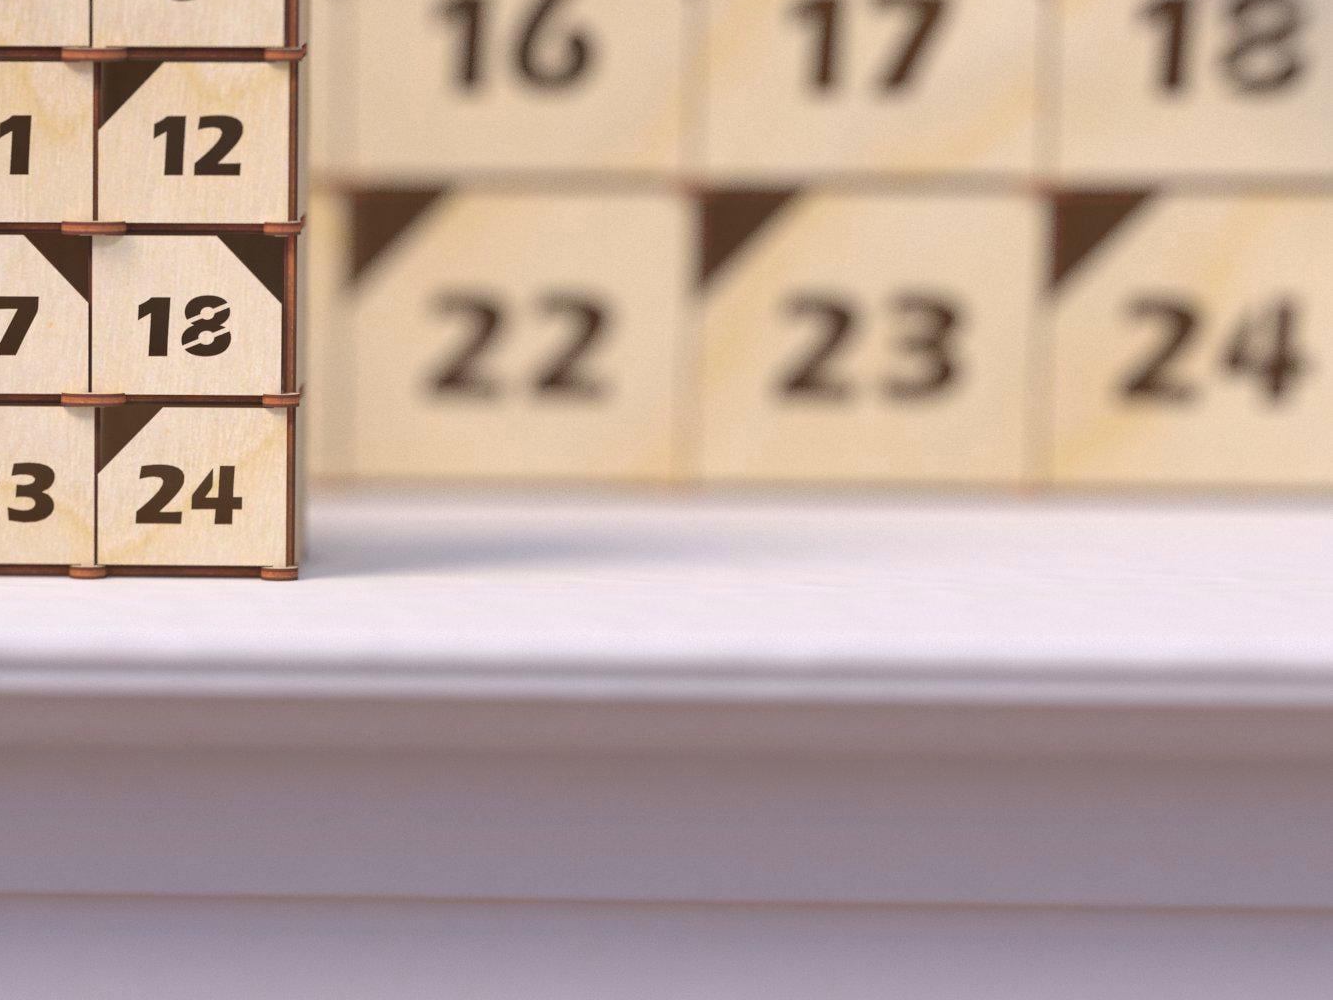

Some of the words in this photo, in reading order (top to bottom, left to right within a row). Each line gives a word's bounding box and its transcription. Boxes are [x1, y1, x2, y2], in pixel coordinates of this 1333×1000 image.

[154, 115, 243, 175] 12
[138, 295, 231, 356] 18
[422, 293, 613, 398] 22
[772, 294, 966, 401] 23
[1112, 297, 1307, 403] 24
[136, 465, 242, 524] 24
